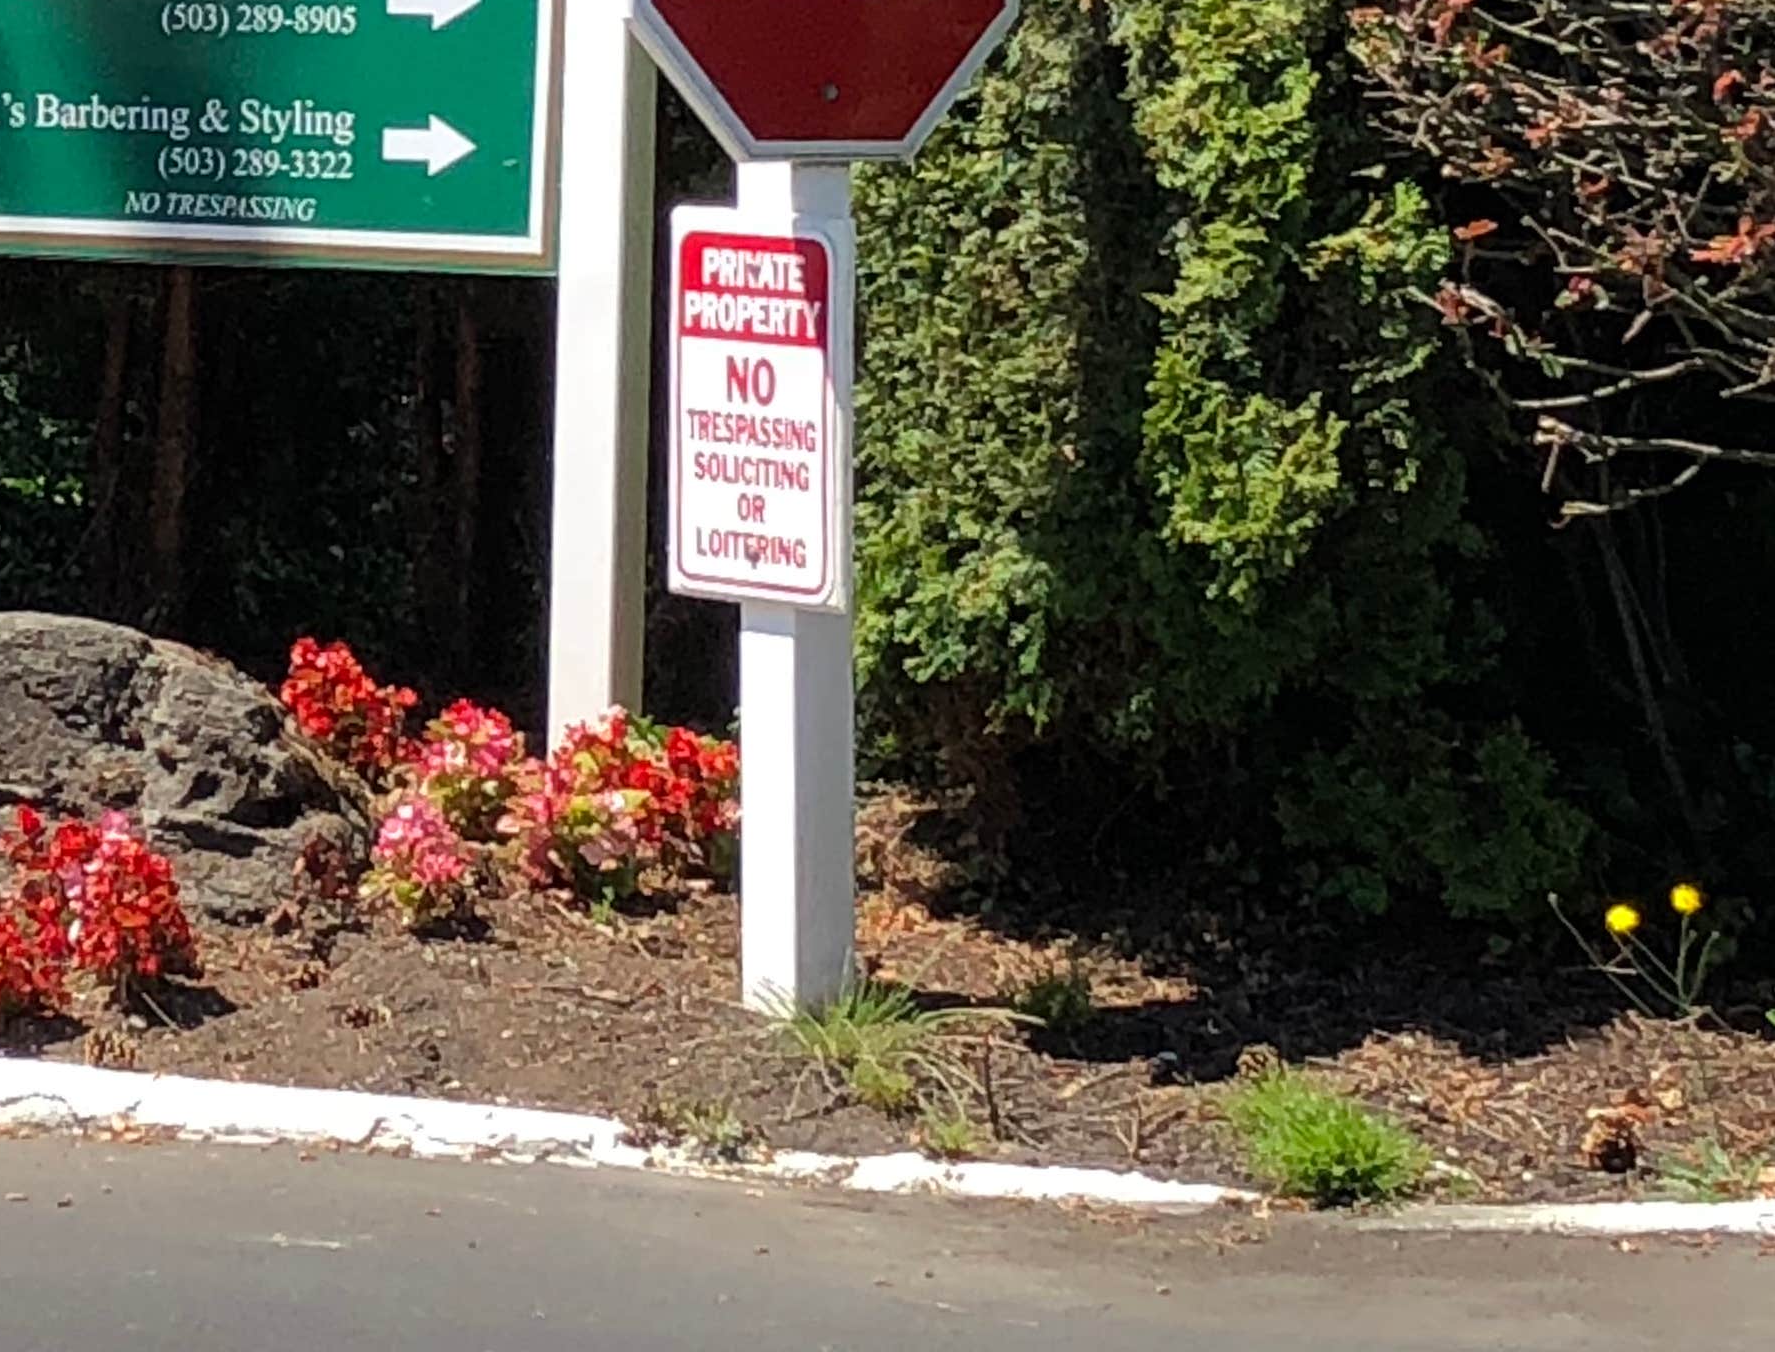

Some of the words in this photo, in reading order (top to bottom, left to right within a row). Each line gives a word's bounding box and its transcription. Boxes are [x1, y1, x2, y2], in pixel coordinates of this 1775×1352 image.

[161, 2, 229, 35] (503)
[237, 3, 357, 36] 289-8905
[35, 93, 190, 137] Barbering
[198, 99, 229, 133] &
[239, 99, 355, 145] Styling
[157, 147, 226, 179] (503)
[232, 148, 353, 181] 289-3322
[125, 192, 161, 215] NO
[166, 193, 317, 222] TRESPASSING
[702, 247, 806, 293] PRIVATE
[684, 291, 821, 339] PROPERTY
[726, 355, 776, 406] NO
[687, 409, 817, 453] TRESPASSING
[694, 451, 809, 492] SOLICITING
[737, 493, 765, 524] OR
[696, 527, 807, 569] LOITERING
